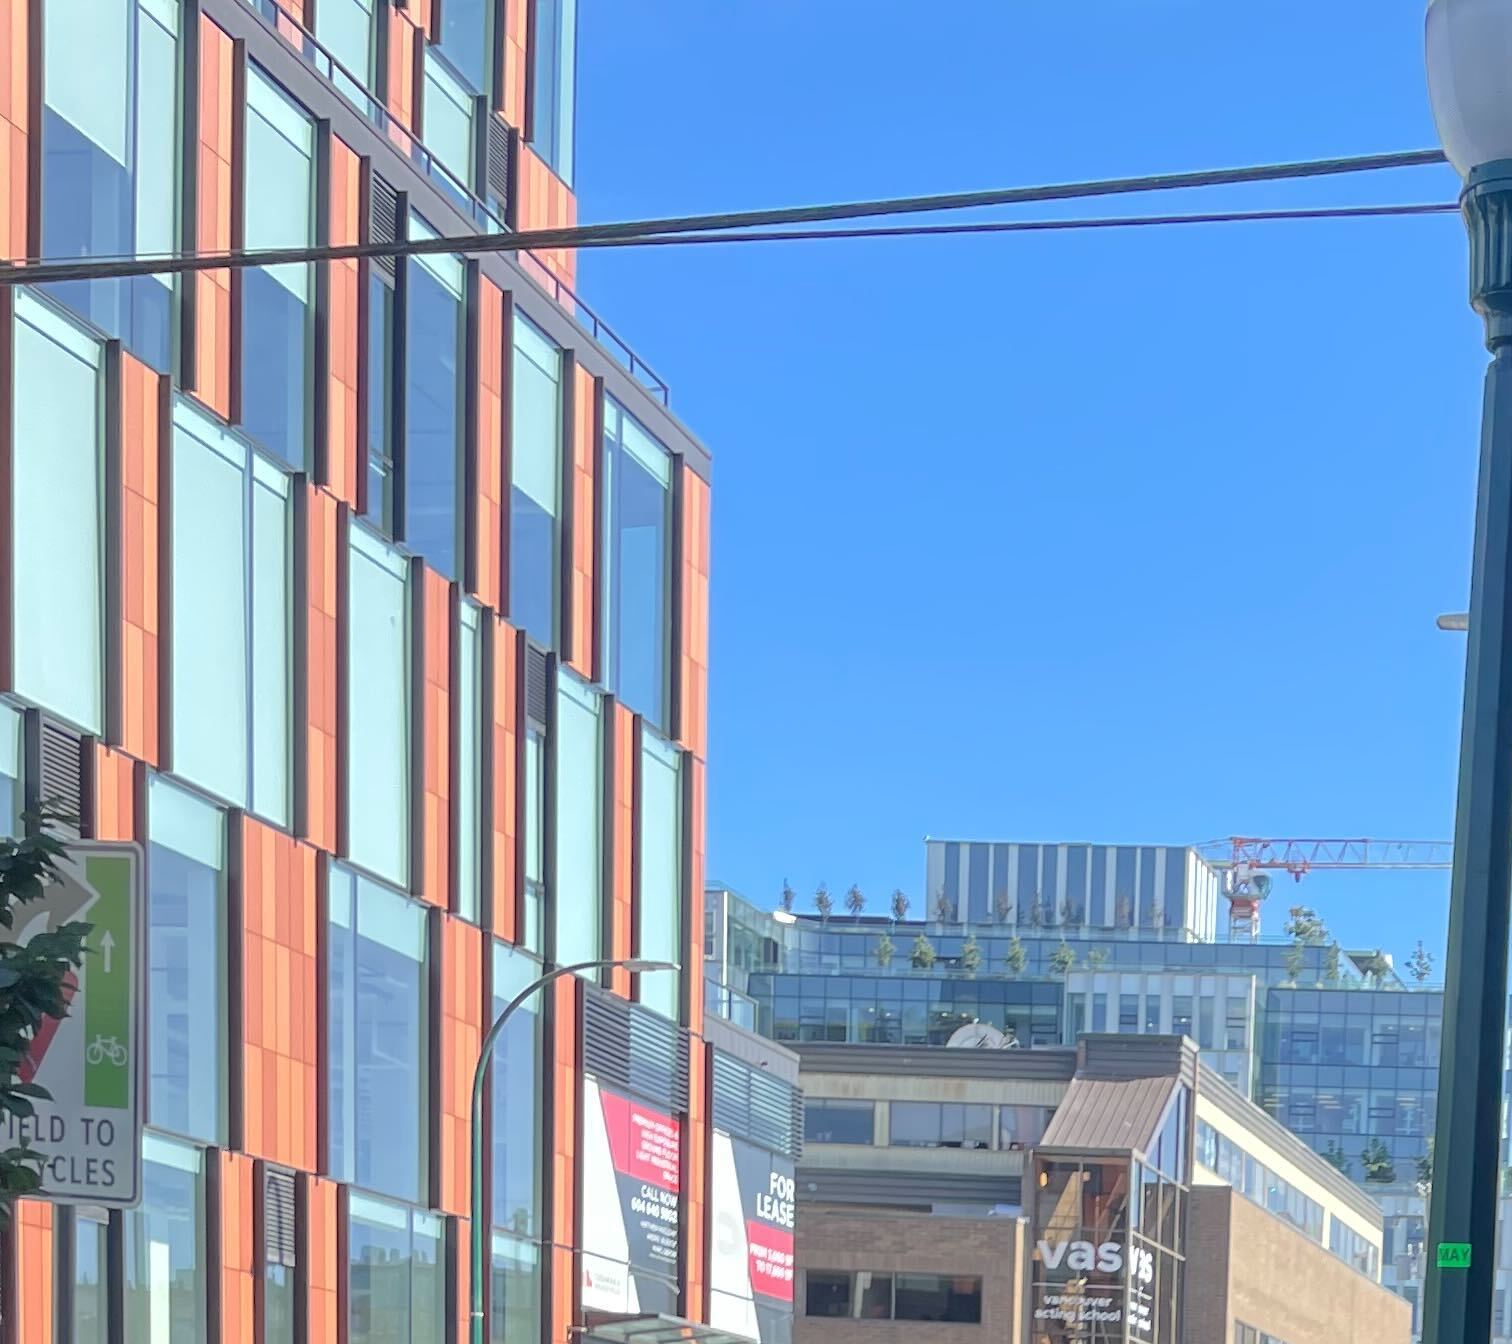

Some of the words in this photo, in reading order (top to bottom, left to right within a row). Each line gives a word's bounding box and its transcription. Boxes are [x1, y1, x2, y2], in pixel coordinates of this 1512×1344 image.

[8, 1113, 65, 1143] IELD
[80, 1117, 115, 1147] TO
[640, 1184, 658, 1203] CALL
[769, 1171, 795, 1203] FOR
[756, 1192, 795, 1229] LEASE
[1036, 1239, 1123, 1273] vas
[1034, 1307, 1076, 1323] acting
[1078, 1309, 1121, 1322] school
